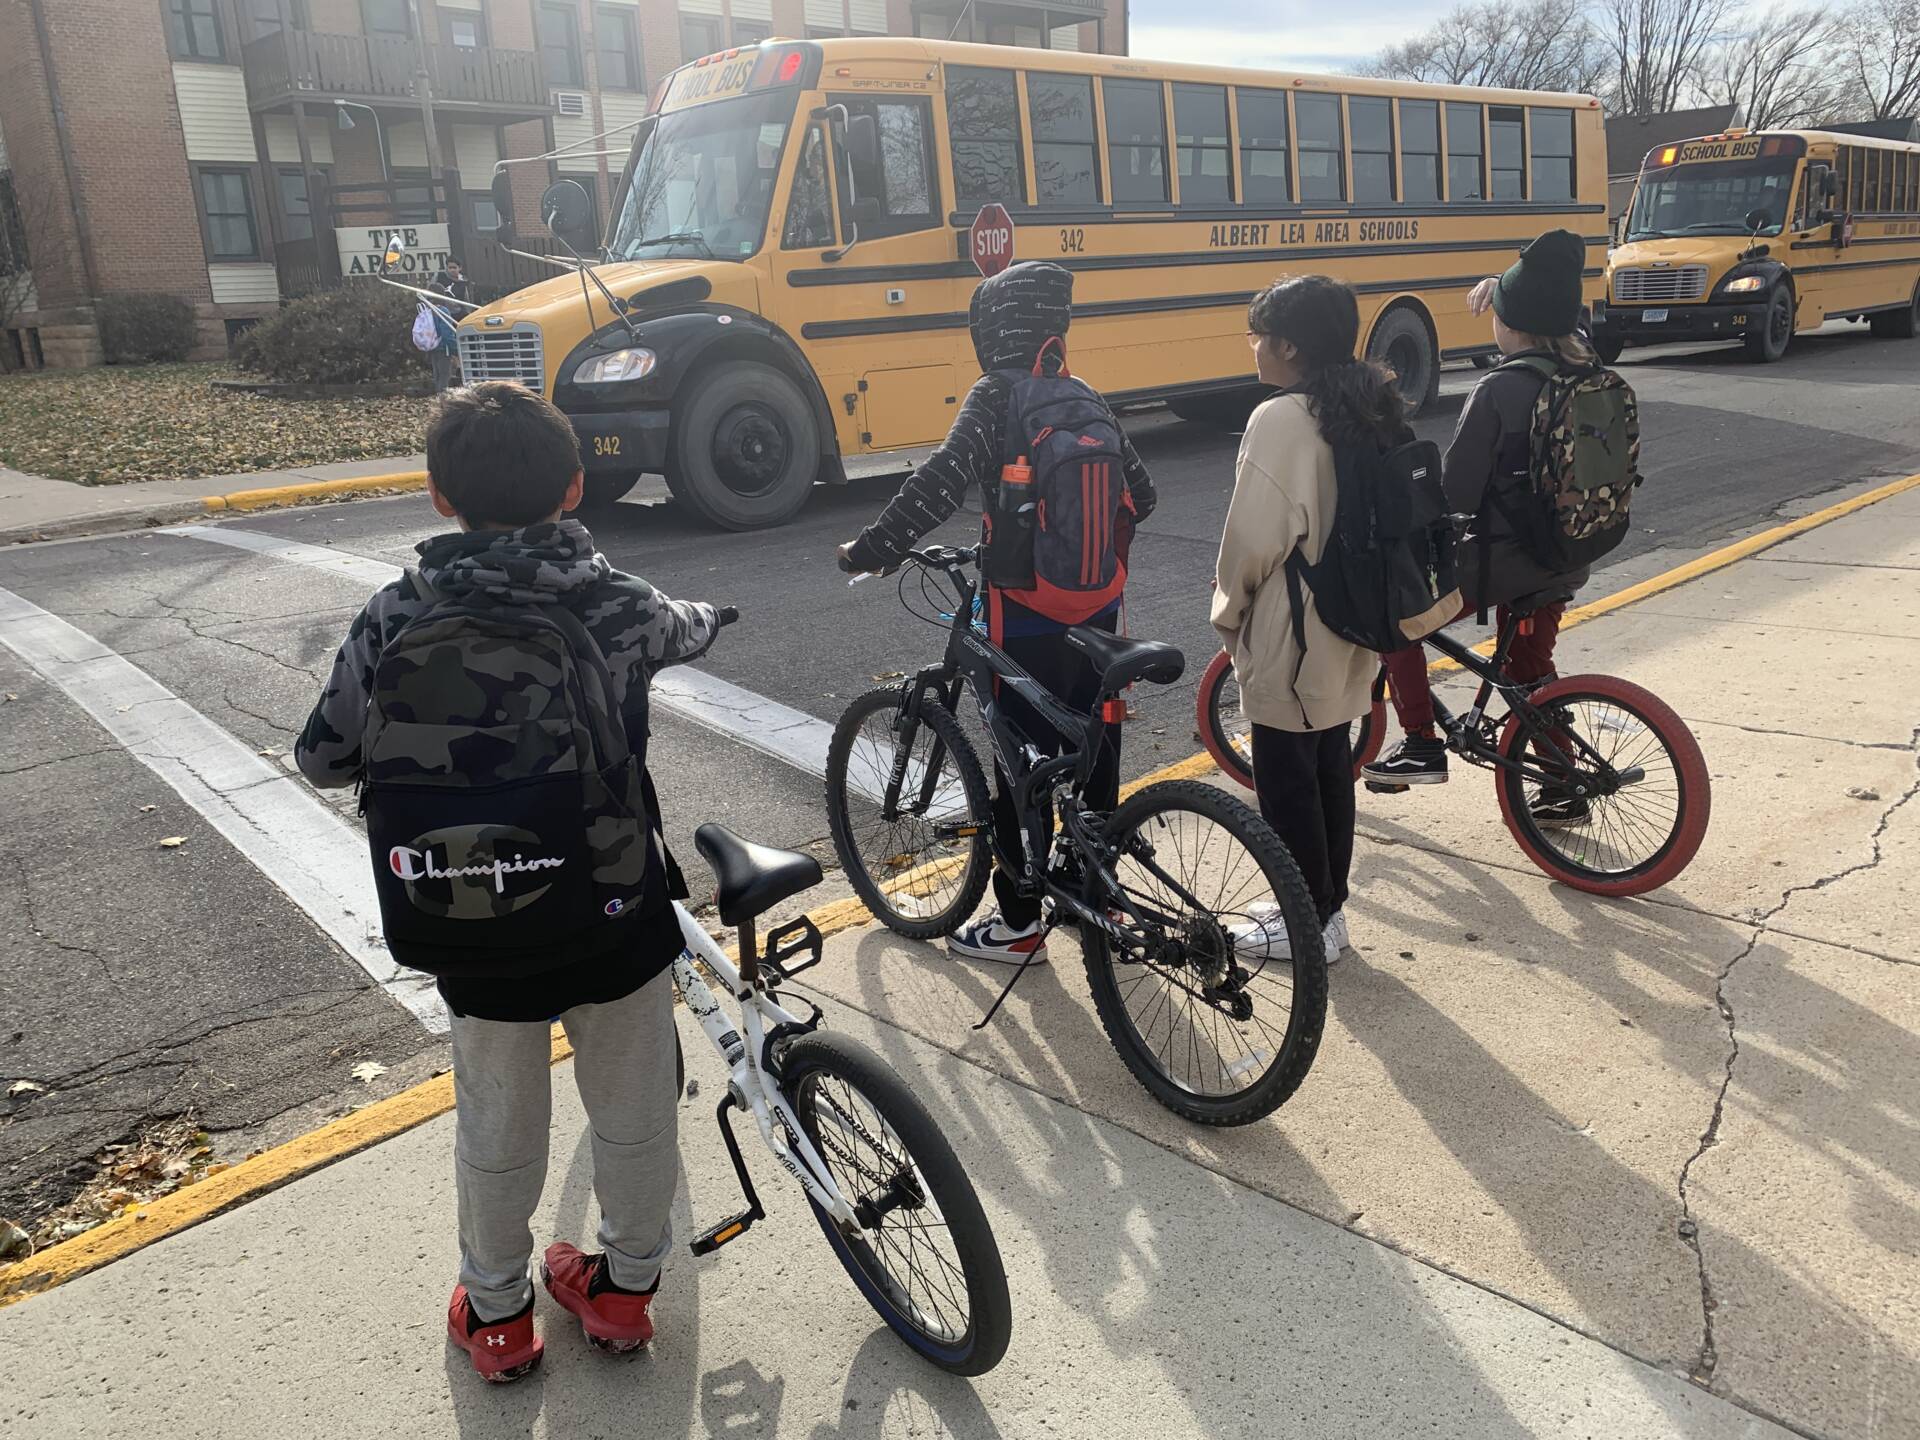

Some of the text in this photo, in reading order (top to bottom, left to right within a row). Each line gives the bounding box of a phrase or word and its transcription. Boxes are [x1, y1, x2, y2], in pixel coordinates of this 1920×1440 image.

[714, 60, 753, 93] BUS
[1680, 141, 1759, 161] SCHOOL BUS
[976, 228, 1009, 256] STOP
[1060, 229, 1084, 253] 342
[1209, 220, 1419, 247] ALBERT LEA AREA SCHOOLS
[349, 252, 448, 274] ABOTT
[593, 436, 621, 456] 342
[389, 846, 565, 893] Champion
[775, 1107, 798, 1141] KENT
